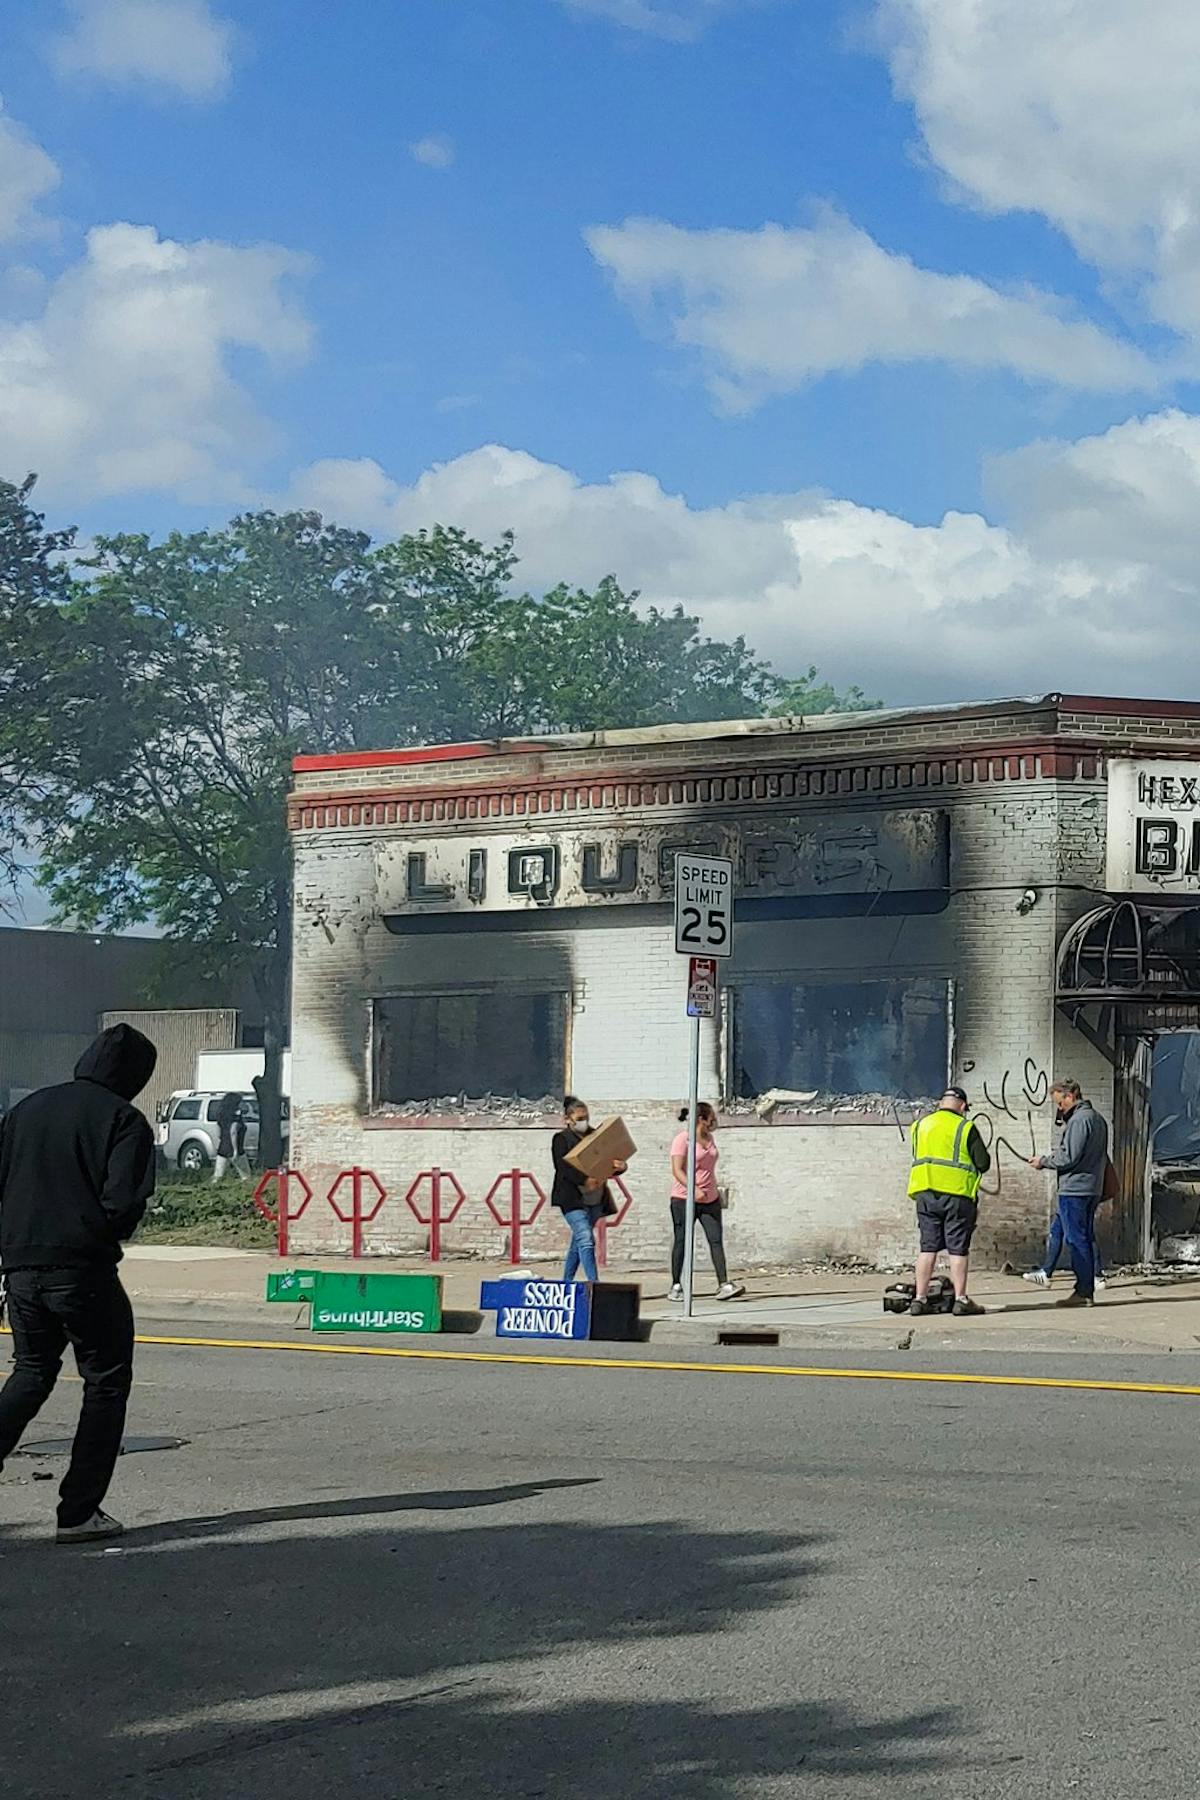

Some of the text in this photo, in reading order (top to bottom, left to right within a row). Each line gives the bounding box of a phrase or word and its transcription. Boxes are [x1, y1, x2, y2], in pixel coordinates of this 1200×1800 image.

[681, 866, 728, 885] SPEED
[686, 887, 723, 905] LIMIT
[681, 907, 727, 945] 25
[525, 1282, 577, 1310] PRESS
[503, 1307, 574, 1337] PIONEER
